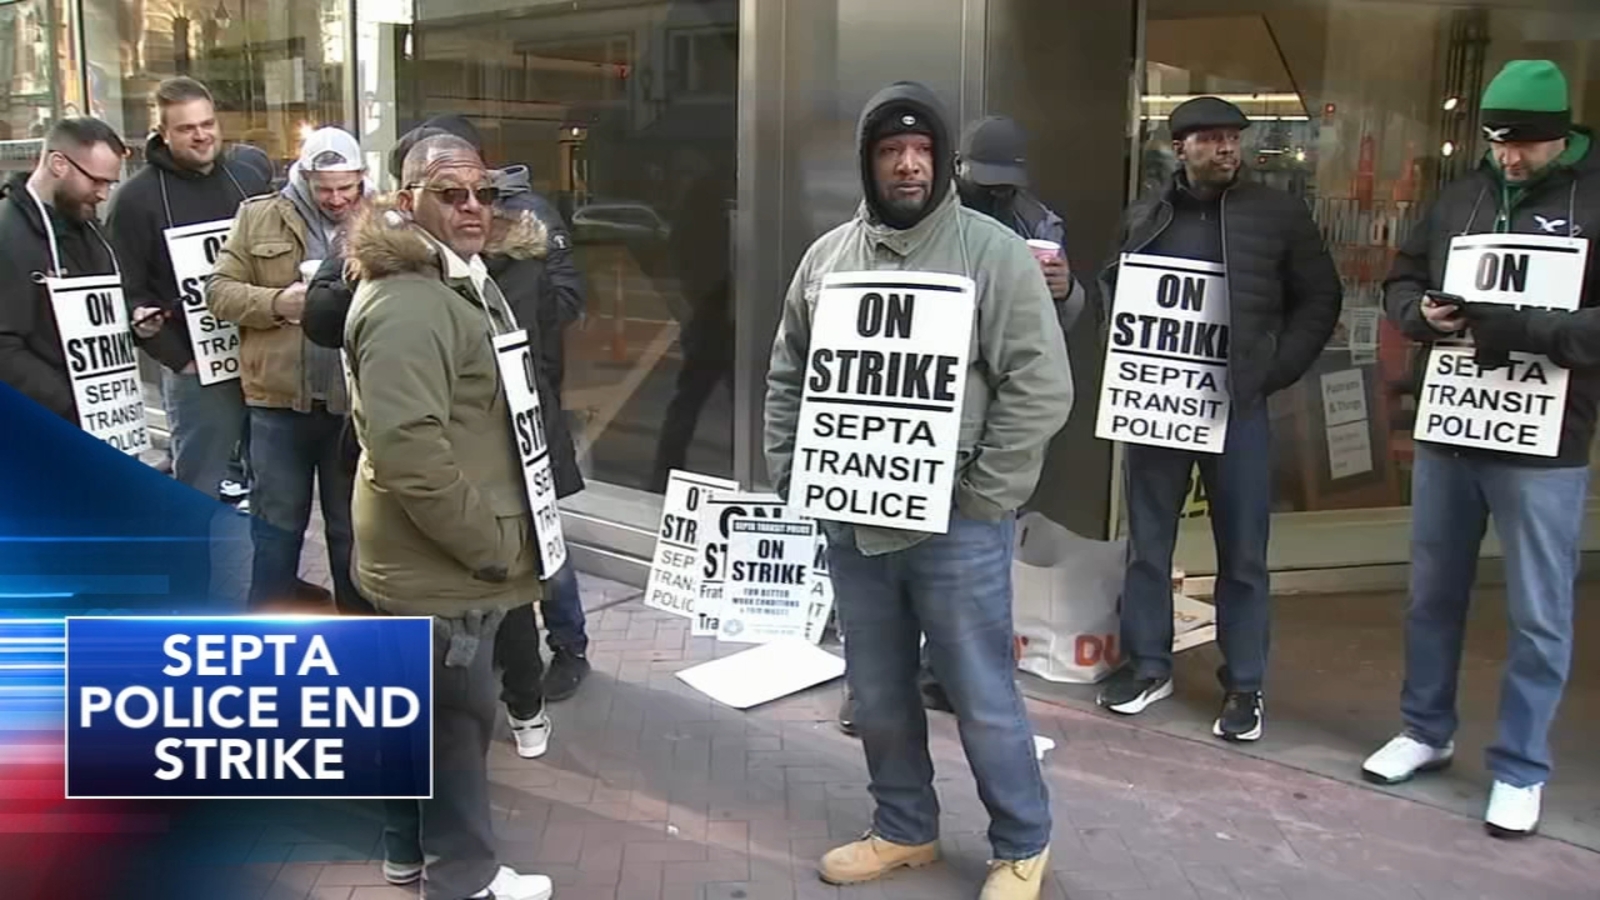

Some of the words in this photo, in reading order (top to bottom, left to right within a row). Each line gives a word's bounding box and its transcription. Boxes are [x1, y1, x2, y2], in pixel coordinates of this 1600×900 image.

[1475, 252, 1530, 293] ON
[1157, 273, 1206, 312] ON
[86, 292, 116, 326] ON
[857, 292, 915, 339] ON
[85, 377, 139, 404] SEPTA
[809, 348, 959, 402] STRIKE
[1119, 361, 1217, 392] SEPTA
[1108, 387, 1224, 419] TRANSIT
[1427, 384, 1556, 415] TRANSIT
[84, 401, 144, 431] TRANSIT
[813, 412, 936, 447] SEPTA
[1112, 415, 1210, 445] POLICE
[1427, 414, 1539, 446] POLICE
[101, 427, 146, 450] OLICE
[801, 447, 944, 485] TRANSIT
[805, 484, 927, 521] POLICE
[758, 539, 784, 560] ON
[732, 560, 807, 585] STRIKE
